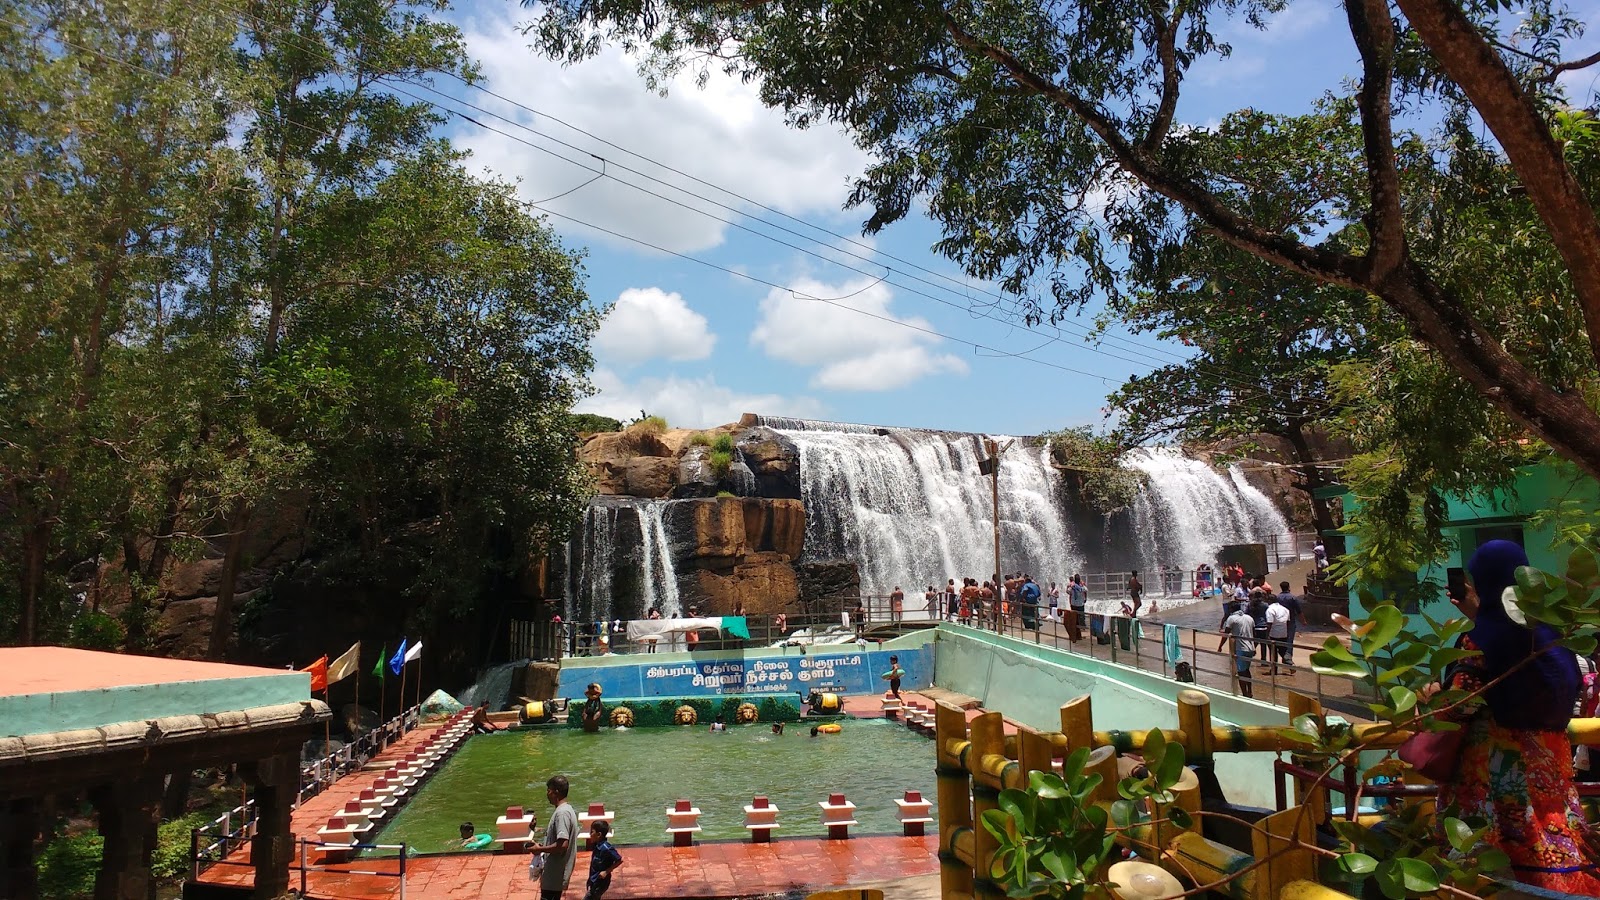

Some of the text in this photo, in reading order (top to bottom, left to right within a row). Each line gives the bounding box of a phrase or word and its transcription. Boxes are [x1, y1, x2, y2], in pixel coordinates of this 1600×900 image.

[703, 662, 744, 675] தேர்வு
[754, 660, 788, 672] நிலை
[692, 672, 742, 688] சிறுவர்
[746, 669, 794, 684] நீச்சல்
